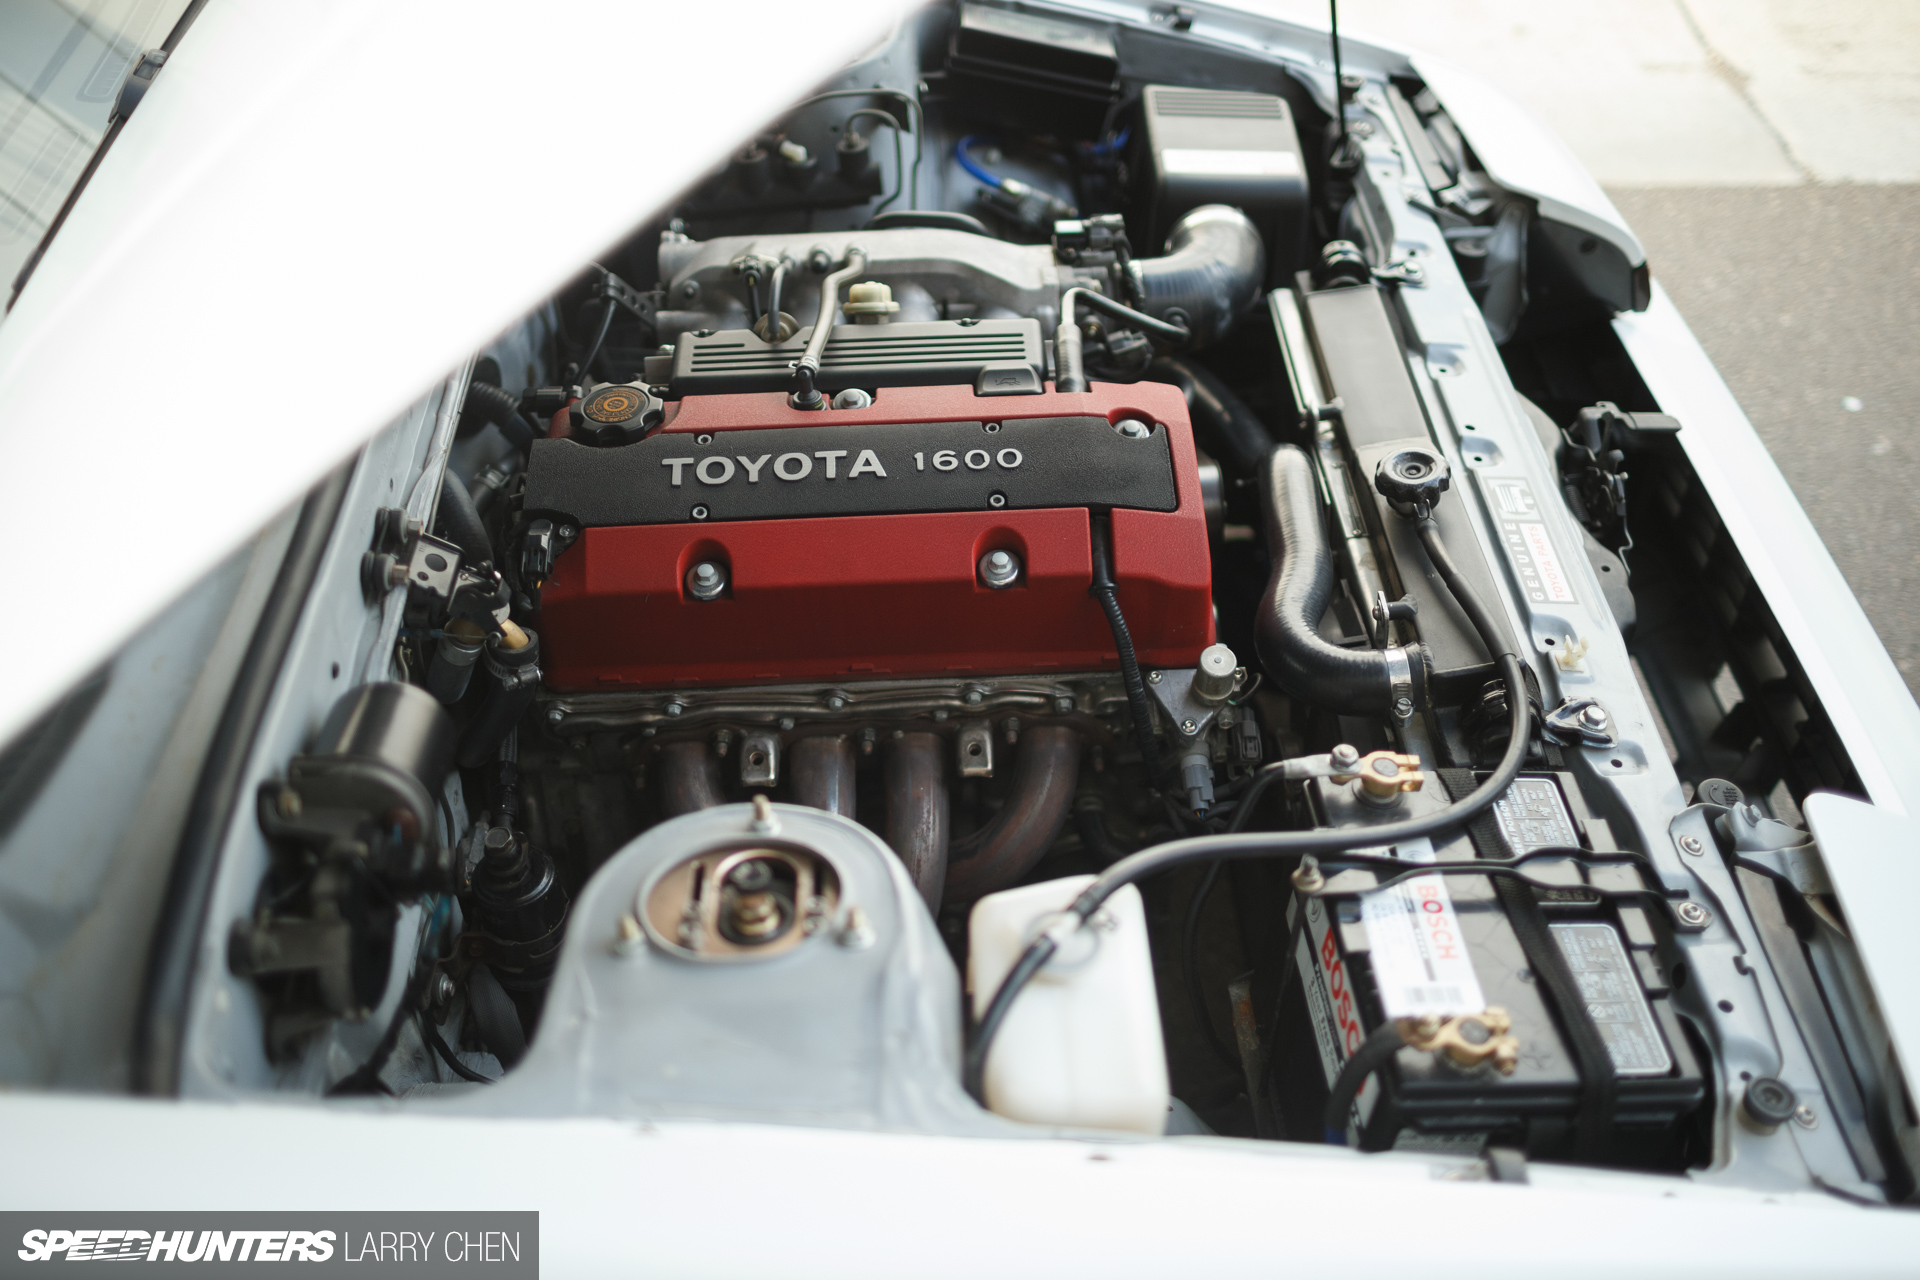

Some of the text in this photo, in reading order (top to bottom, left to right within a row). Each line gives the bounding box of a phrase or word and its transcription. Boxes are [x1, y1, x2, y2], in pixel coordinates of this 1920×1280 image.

[662, 448, 1023, 486] TOYOTA 1600
[1504, 522, 1544, 601] GENUINE
[1528, 526, 1565, 599] TOYOTA PARTS
[1498, 799, 1525, 856] GER/POISON
[1417, 885, 1459, 959] BOSCH
[1321, 926, 1362, 1062] BOSC
